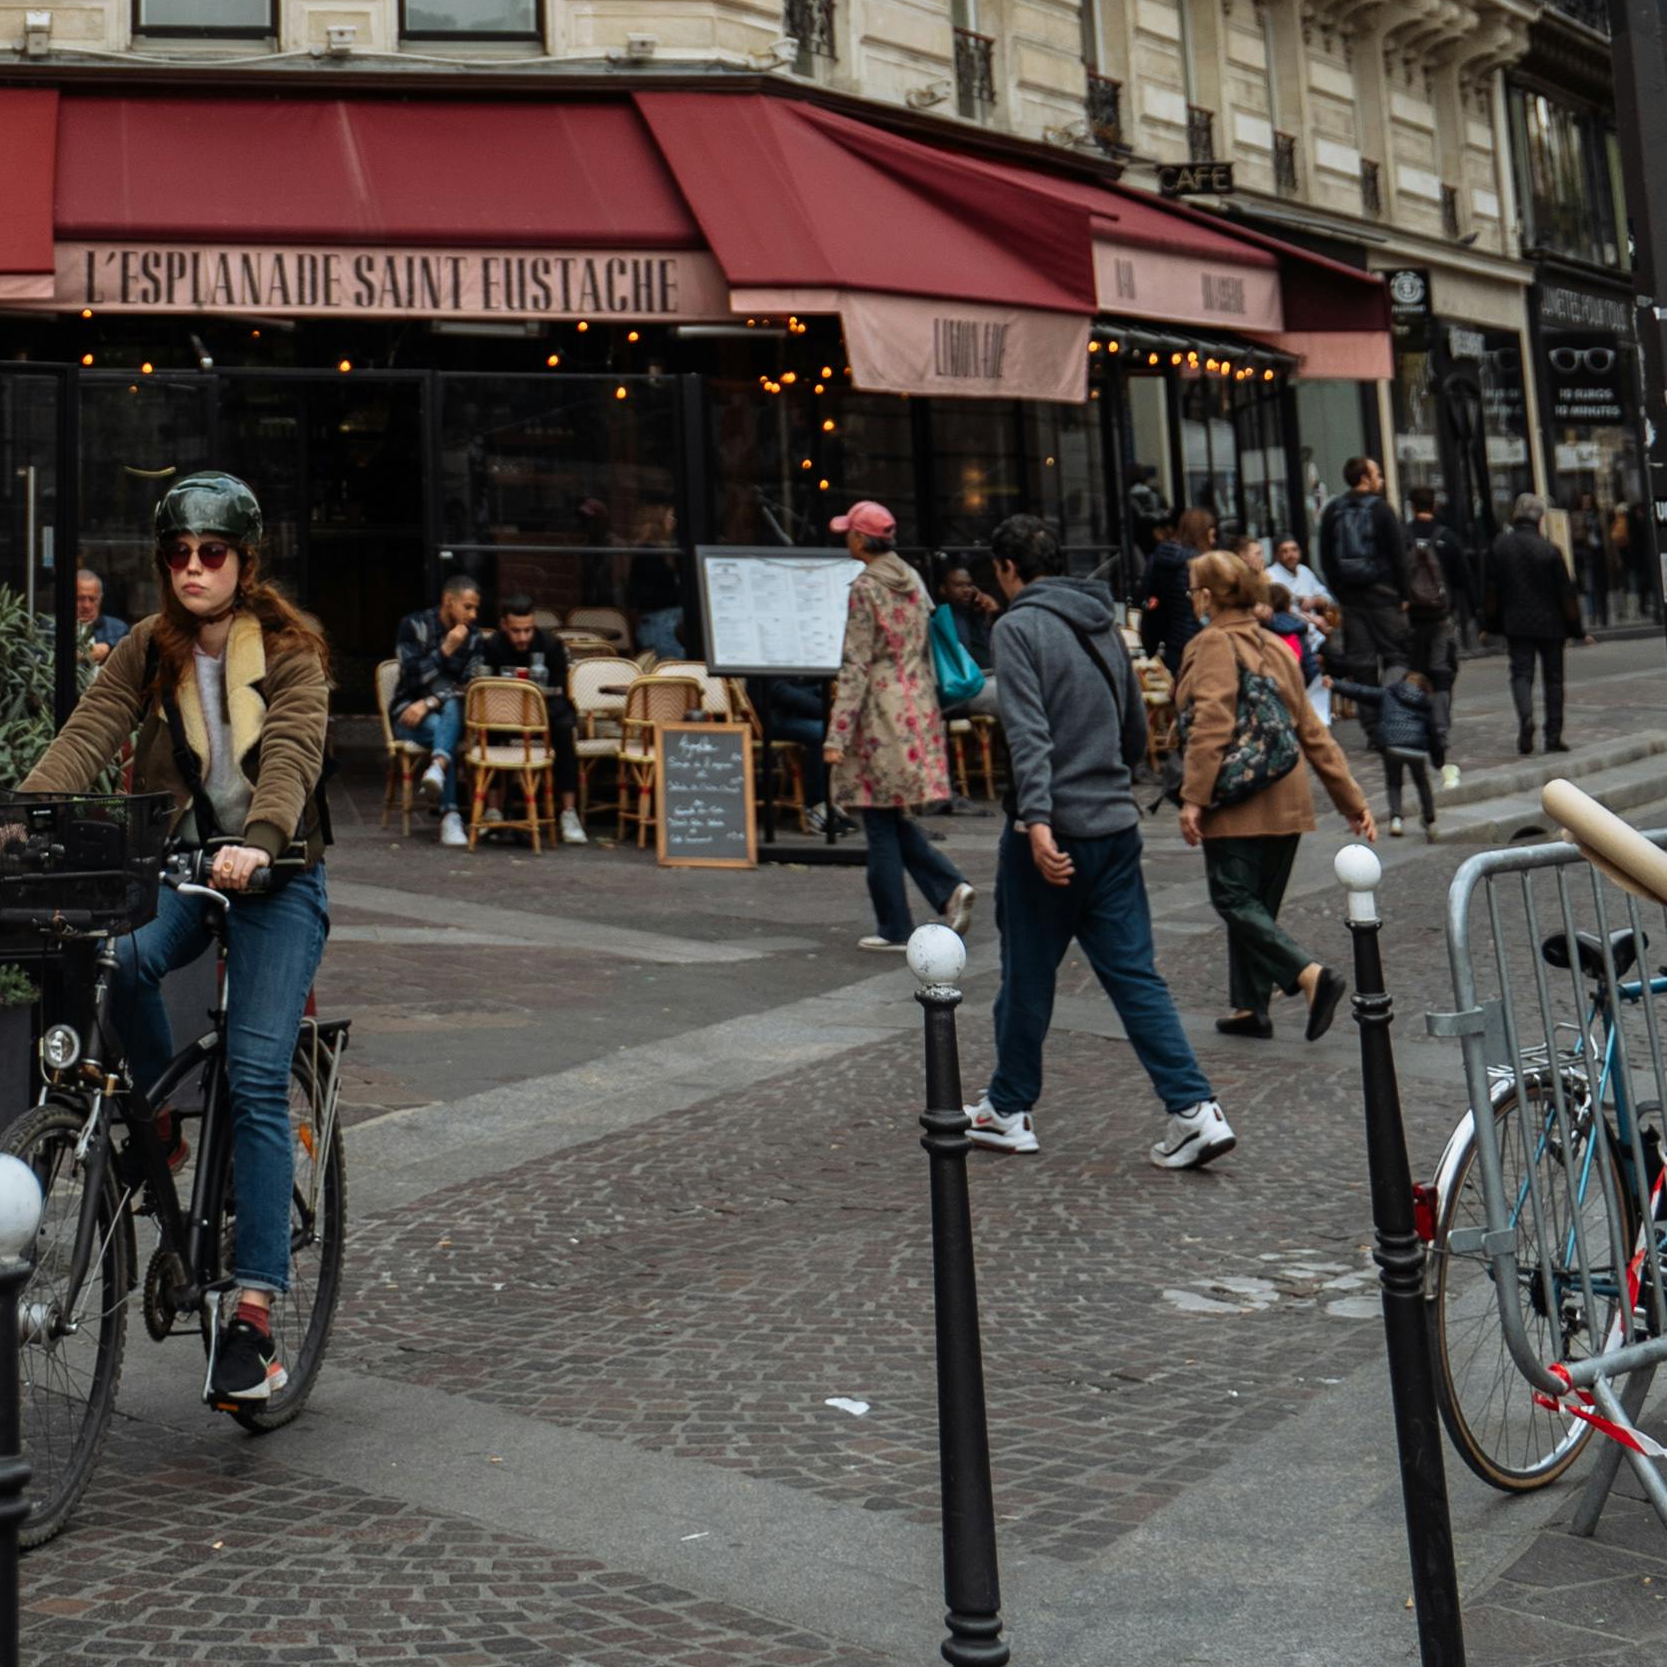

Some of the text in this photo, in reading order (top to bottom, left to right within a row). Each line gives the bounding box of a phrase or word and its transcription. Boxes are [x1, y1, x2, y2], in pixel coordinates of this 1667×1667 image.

[86, 250, 679, 314] L'ESPLANADE SAINT EUSTACHE
